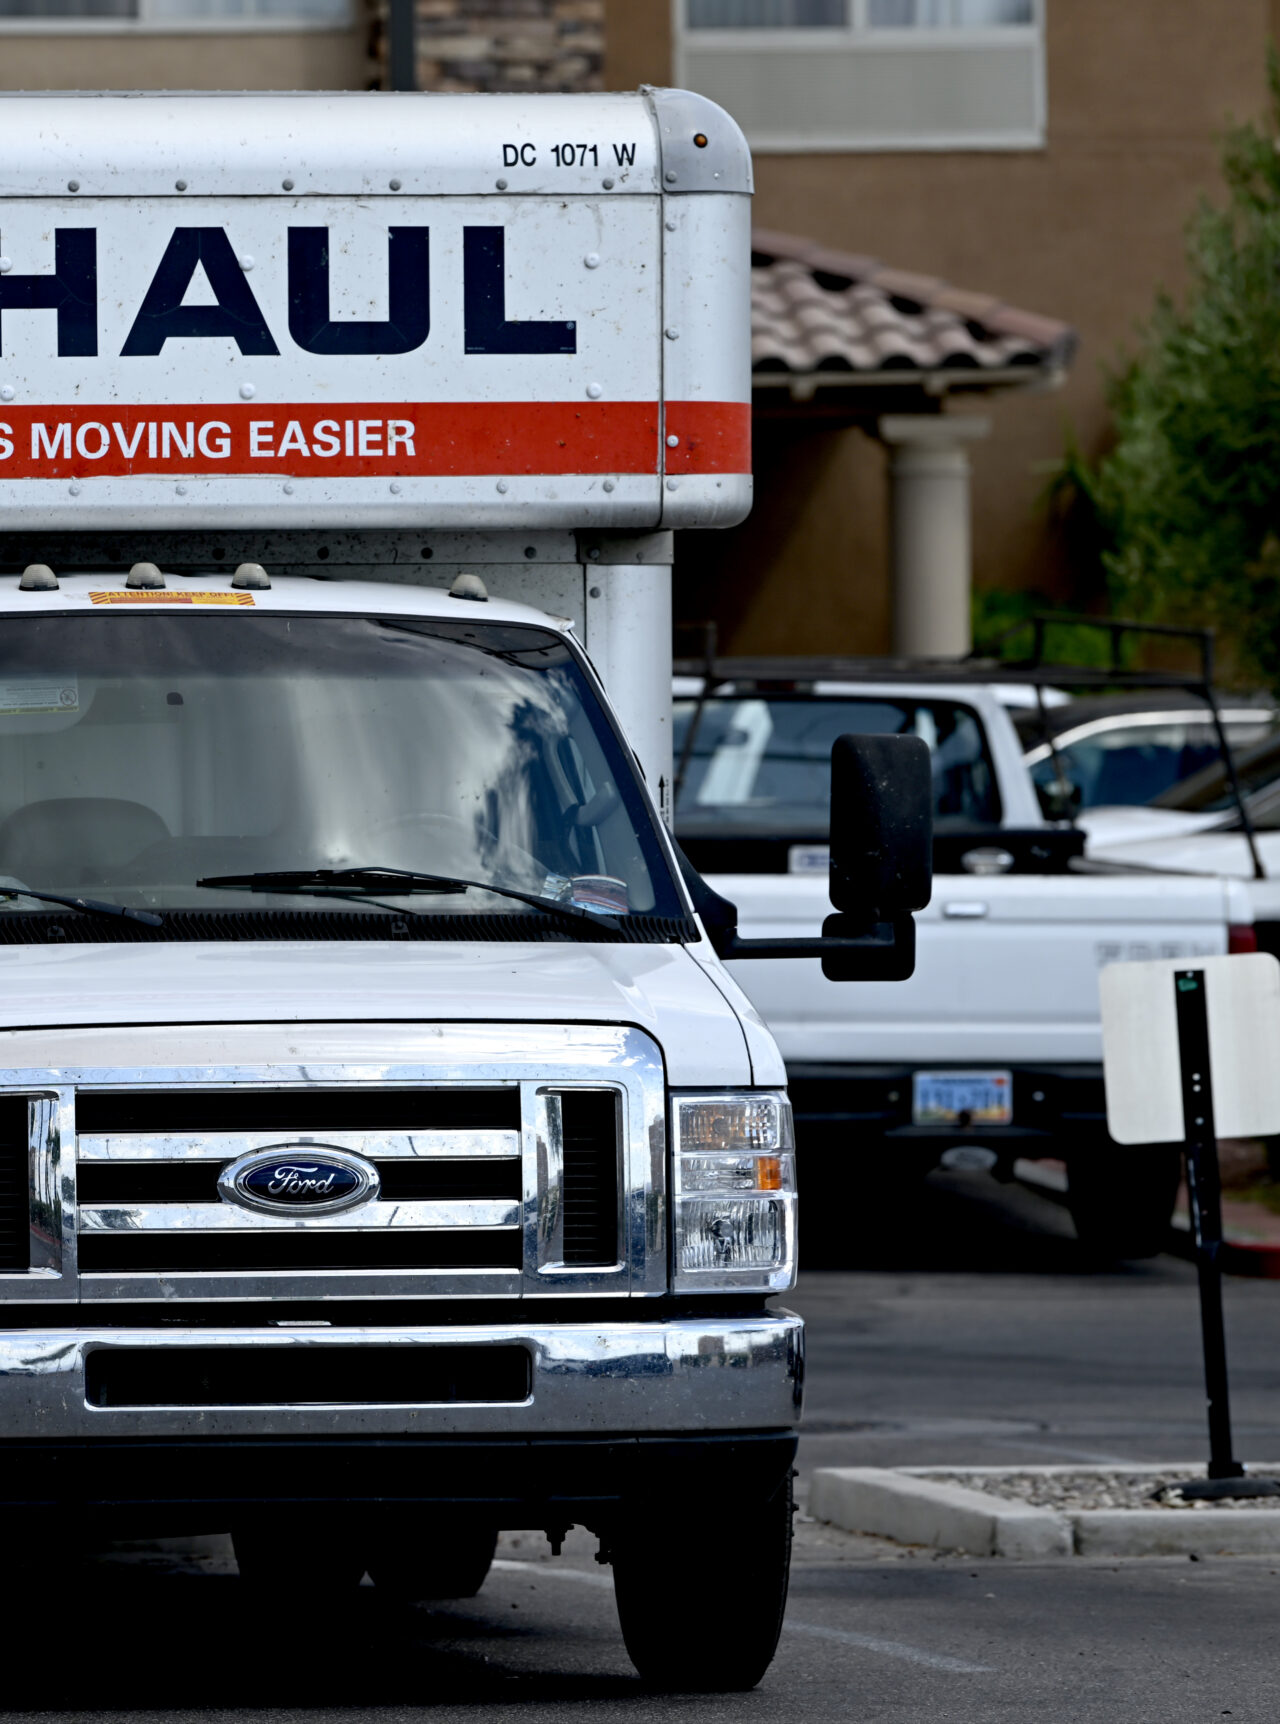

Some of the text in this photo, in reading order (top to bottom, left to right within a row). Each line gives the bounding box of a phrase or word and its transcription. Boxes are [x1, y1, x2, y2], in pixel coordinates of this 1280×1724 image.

[503, 142, 637, 168] DC 1071 W
[31, 420, 232, 460] MOVING
[249, 419, 416, 458] EASIER
[268, 1165, 335, 1195] Ford
